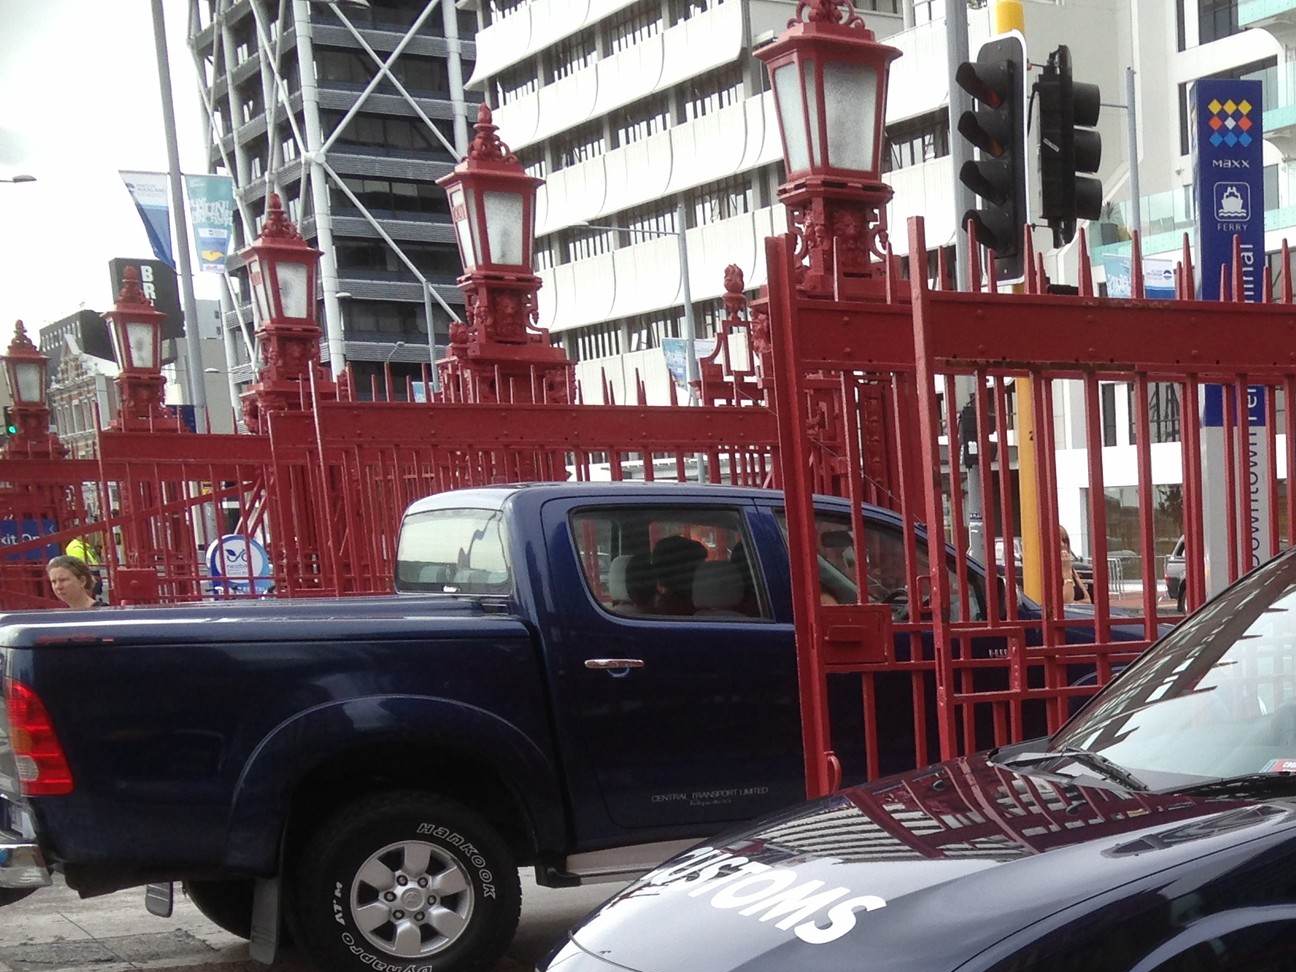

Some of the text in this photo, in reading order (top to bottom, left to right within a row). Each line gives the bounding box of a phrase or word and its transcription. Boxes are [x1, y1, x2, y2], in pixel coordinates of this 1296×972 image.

[1217, 223, 1249, 231] FERRY
[141, 265, 157, 307] BR
[651, 793, 687, 803] CENTRAL
[691, 788, 737, 800] TRANSPORT
[740, 786, 769, 796] LIMITED
